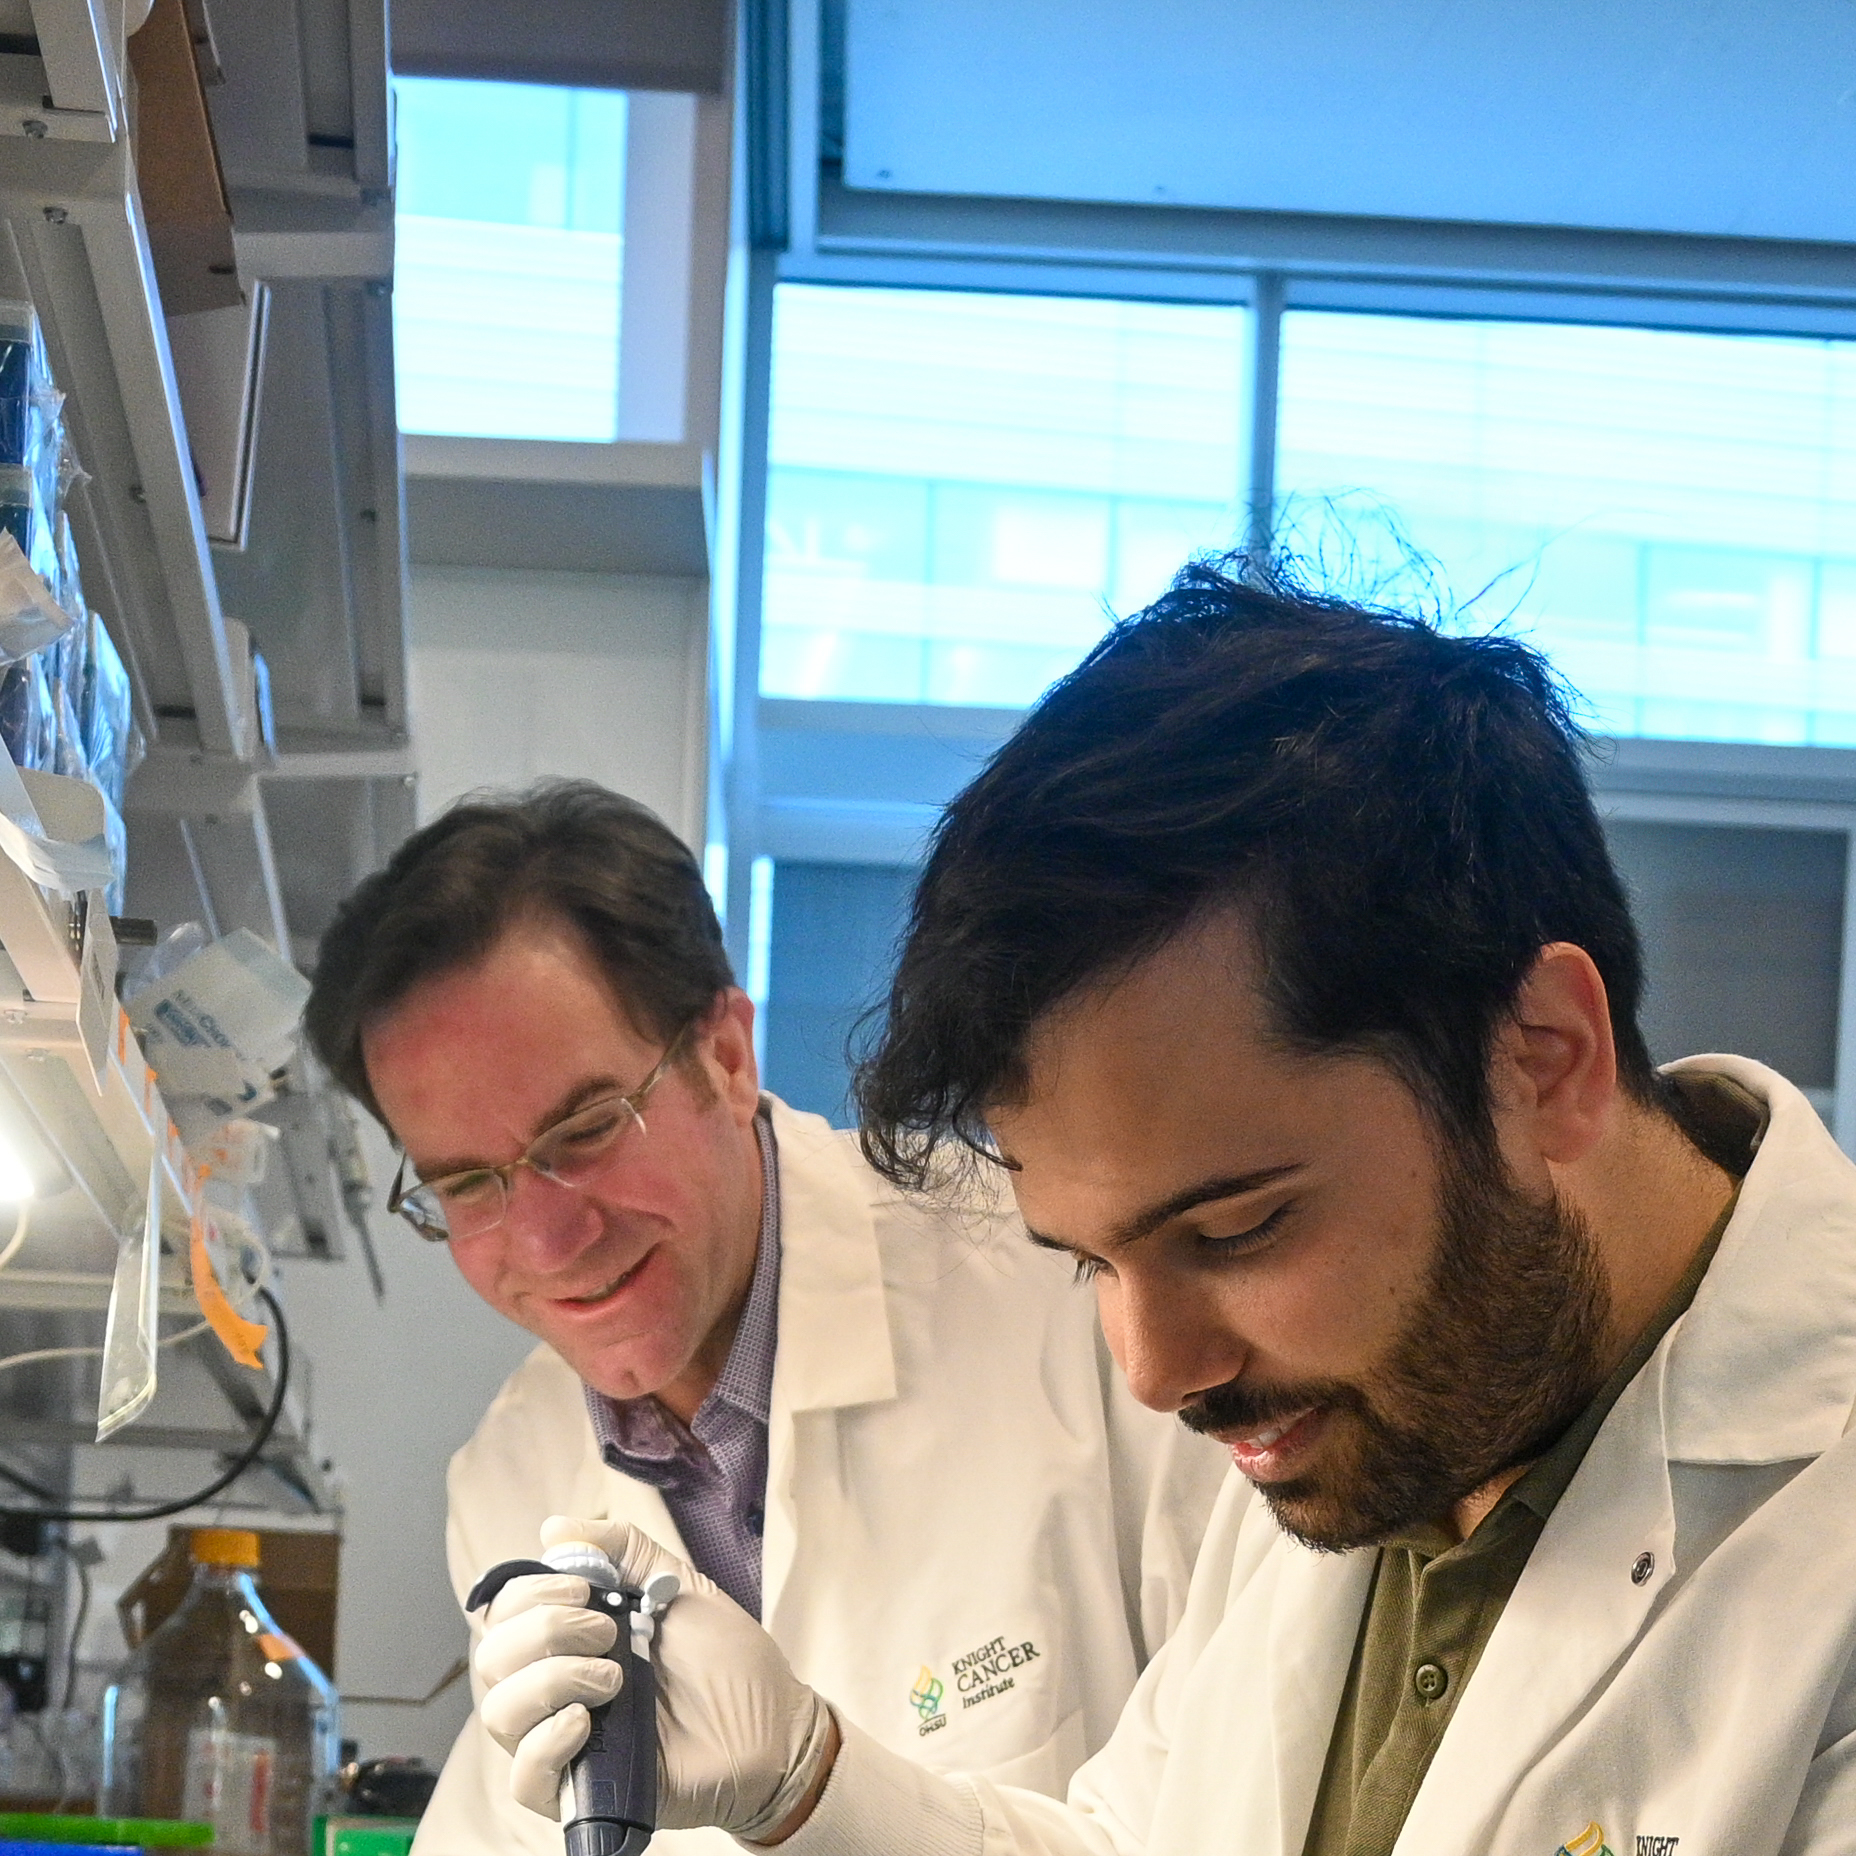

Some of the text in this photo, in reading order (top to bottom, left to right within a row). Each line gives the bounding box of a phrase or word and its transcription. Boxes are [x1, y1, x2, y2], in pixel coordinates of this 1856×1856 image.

[953, 1635, 1008, 1676] KNIGHT
[956, 1640, 1040, 1693] CANCER
[962, 1675, 1015, 1710] Institute
[918, 1716, 947, 1738] OHSU
